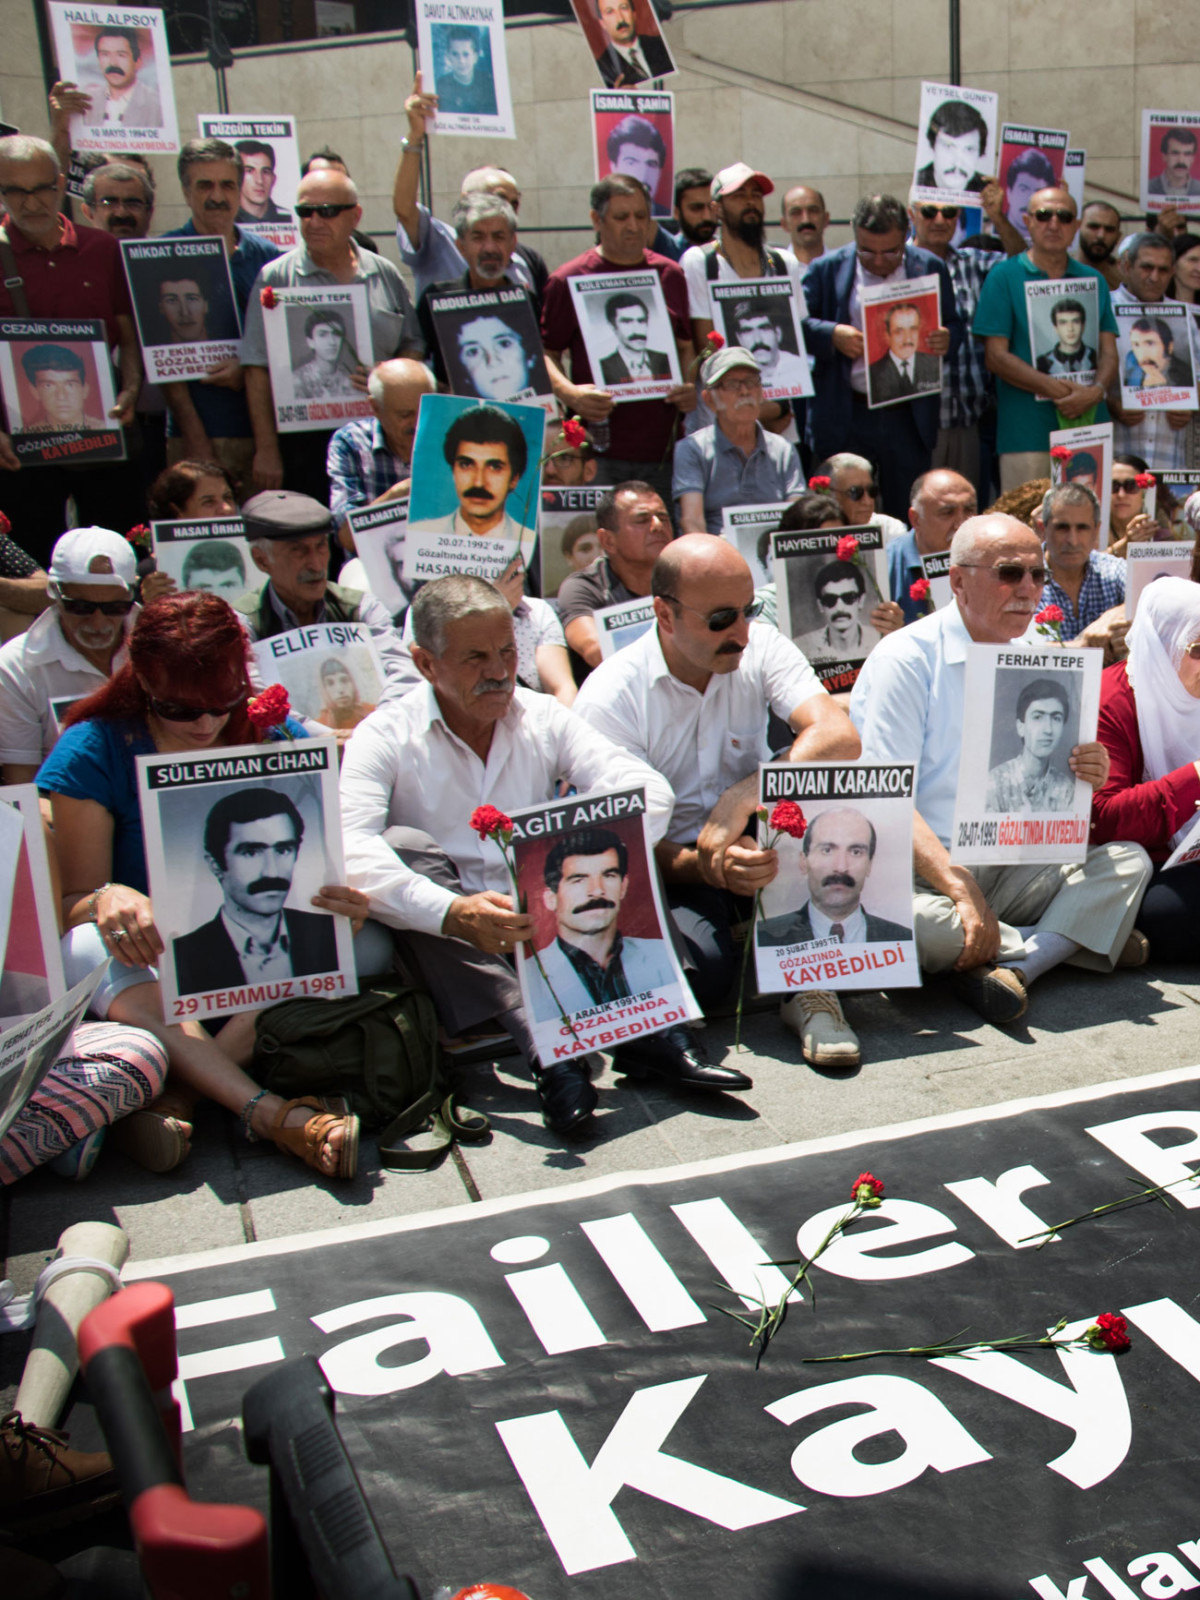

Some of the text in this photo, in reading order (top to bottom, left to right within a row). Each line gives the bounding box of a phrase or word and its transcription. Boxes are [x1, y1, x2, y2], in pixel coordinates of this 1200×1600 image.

[64, 9, 158, 27] HALİL ALPSOY
[424, 3, 494, 22] DAVUT ALTINKAYNAK
[925, 85, 963, 99] VEYSEL
[595, 93, 634, 110] İSMAİL
[209, 122, 286, 136] DÜZGÜN TEKİN
[1004, 128, 1035, 143] İSMAİL
[129, 242, 220, 259] MİKDAT ÖZEKEN
[578, 279, 625, 290] SÜLEYMAN
[714, 284, 791, 298] MEHMET ERTAK
[1027, 284, 1062, 296] CÜNEYT
[327, 293, 352, 302] TEPE
[499, 288, 526, 302] DAĞ
[1, 323, 48, 334] CEZAİR
[152, 349, 165, 359] 27
[169, 345, 197, 357] EKİM
[16, 432, 82, 453] GÖZALTINDA
[41, 433, 118, 460] KAYBEDİLDİ
[1162, 473, 1187, 484] HALİL
[733, 510, 783, 524] SÜLEYMAN
[173, 524, 209, 537] HASAN
[417, 548, 468, 562] Gözaltında
[1130, 547, 1173, 559] ABDURRAHMAN
[415, 561, 461, 576] HASAN
[270, 625, 365, 658] ELİF IŞIK
[997, 653, 1084, 669] FERHAT TEPE
[156, 750, 325, 784] SÜLEYMAN CİHAN
[766, 767, 912, 798] RIDVAN KARAKOÇ
[510, 791, 645, 840] AGİT AKİPA
[957, 813, 1088, 847] 28-07-1993 GÖZALTINDA KAYBEDİLDİ
[775, 936, 839, 958] 20 ŞUBAT 1995'TE
[779, 947, 843, 970] GÖZALTINDA
[783, 942, 906, 988] KAYBEDİLDİ
[173, 974, 347, 1017] 29 TEMMUZ 1981
[575, 1002, 613, 1021] ARALIK
[614, 990, 654, 1010] 1991'DE
[559, 996, 669, 1036] GÖZALTINDA
[552, 1005, 688, 1059] KAYBEDİLDİ
